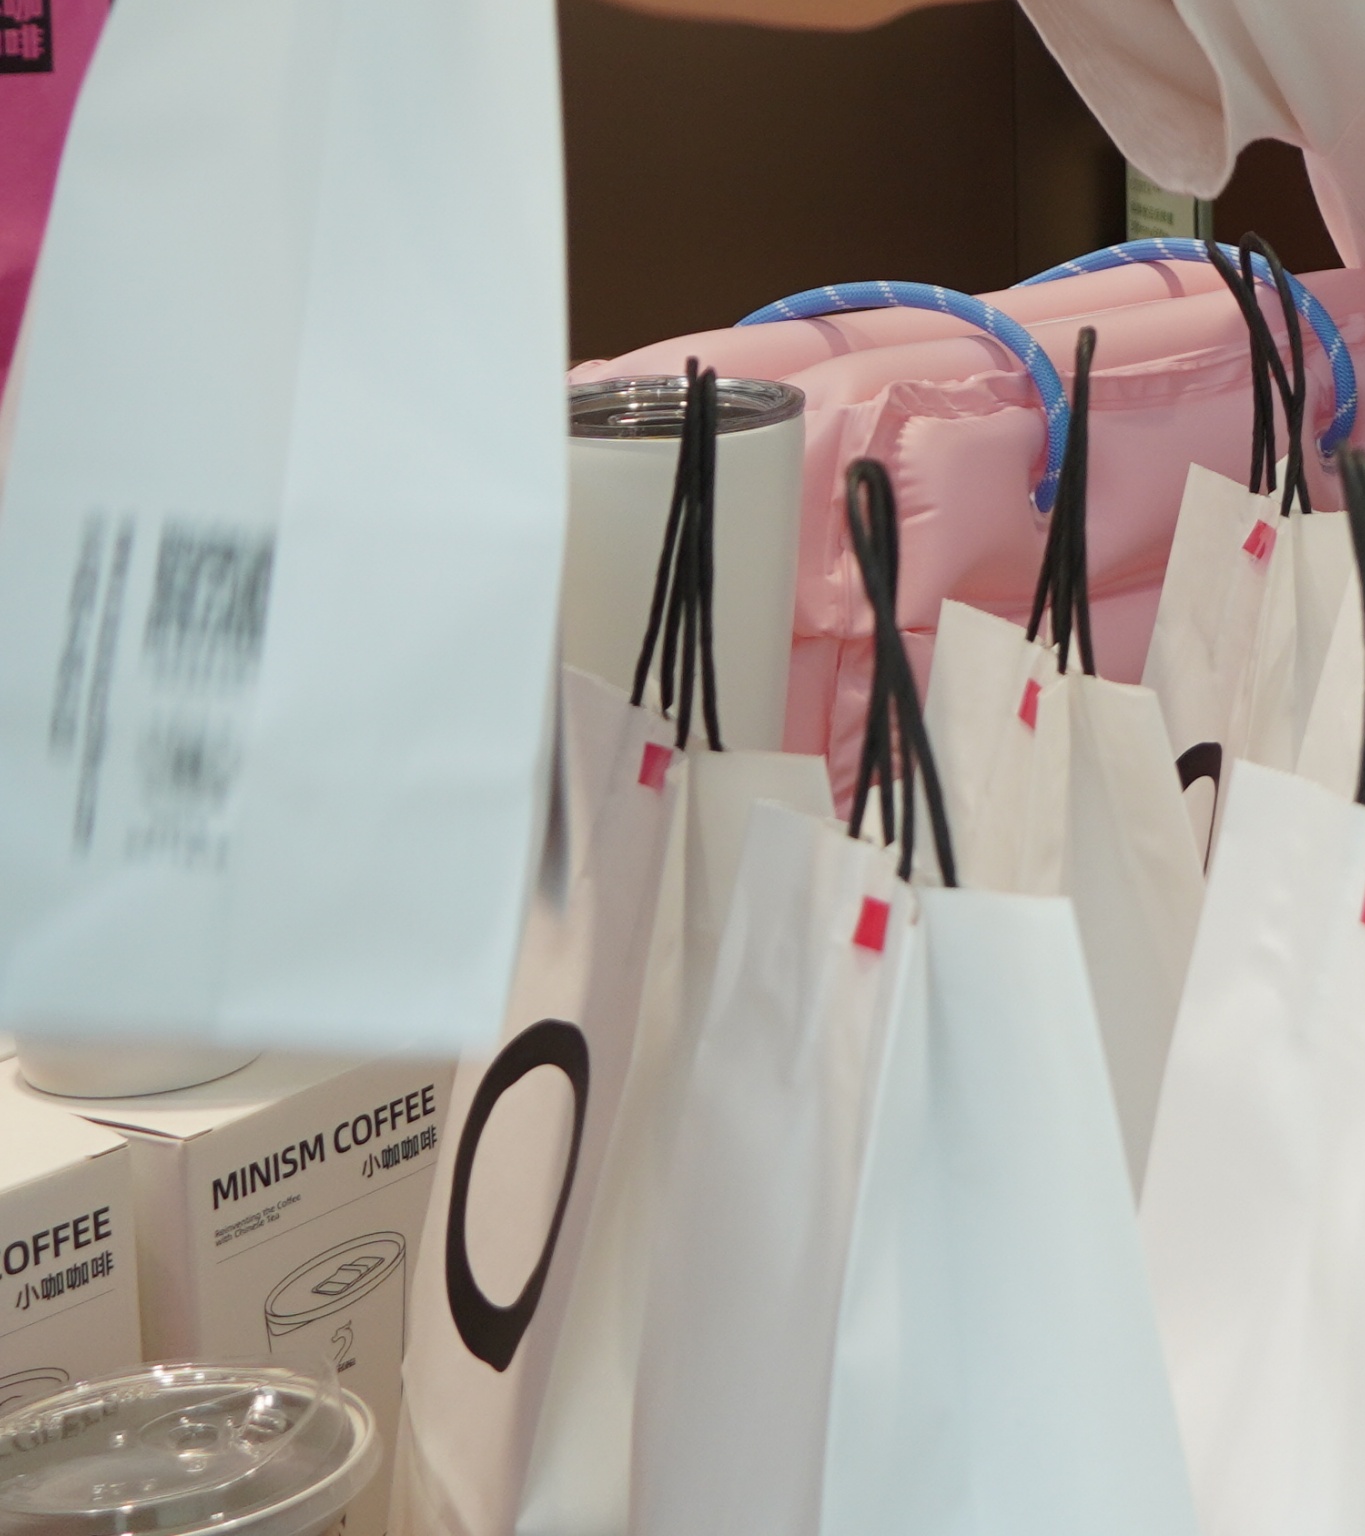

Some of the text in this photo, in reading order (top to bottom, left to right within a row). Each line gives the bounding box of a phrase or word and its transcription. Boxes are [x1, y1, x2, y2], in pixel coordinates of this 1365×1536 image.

[0, 24, 45, 59] 啡
[212, 1084, 436, 1210] MINISM COFFEE
[362, 1125, 437, 1178] 小咖咖啡
[263, 1205, 275, 1216] the
[277, 1194, 302, 1210] Coffee
[266, 1213, 280, 1224] Tea
[0, 1206, 112, 1279] OFFEE
[16, 1250, 114, 1310] 小咖咖啡
